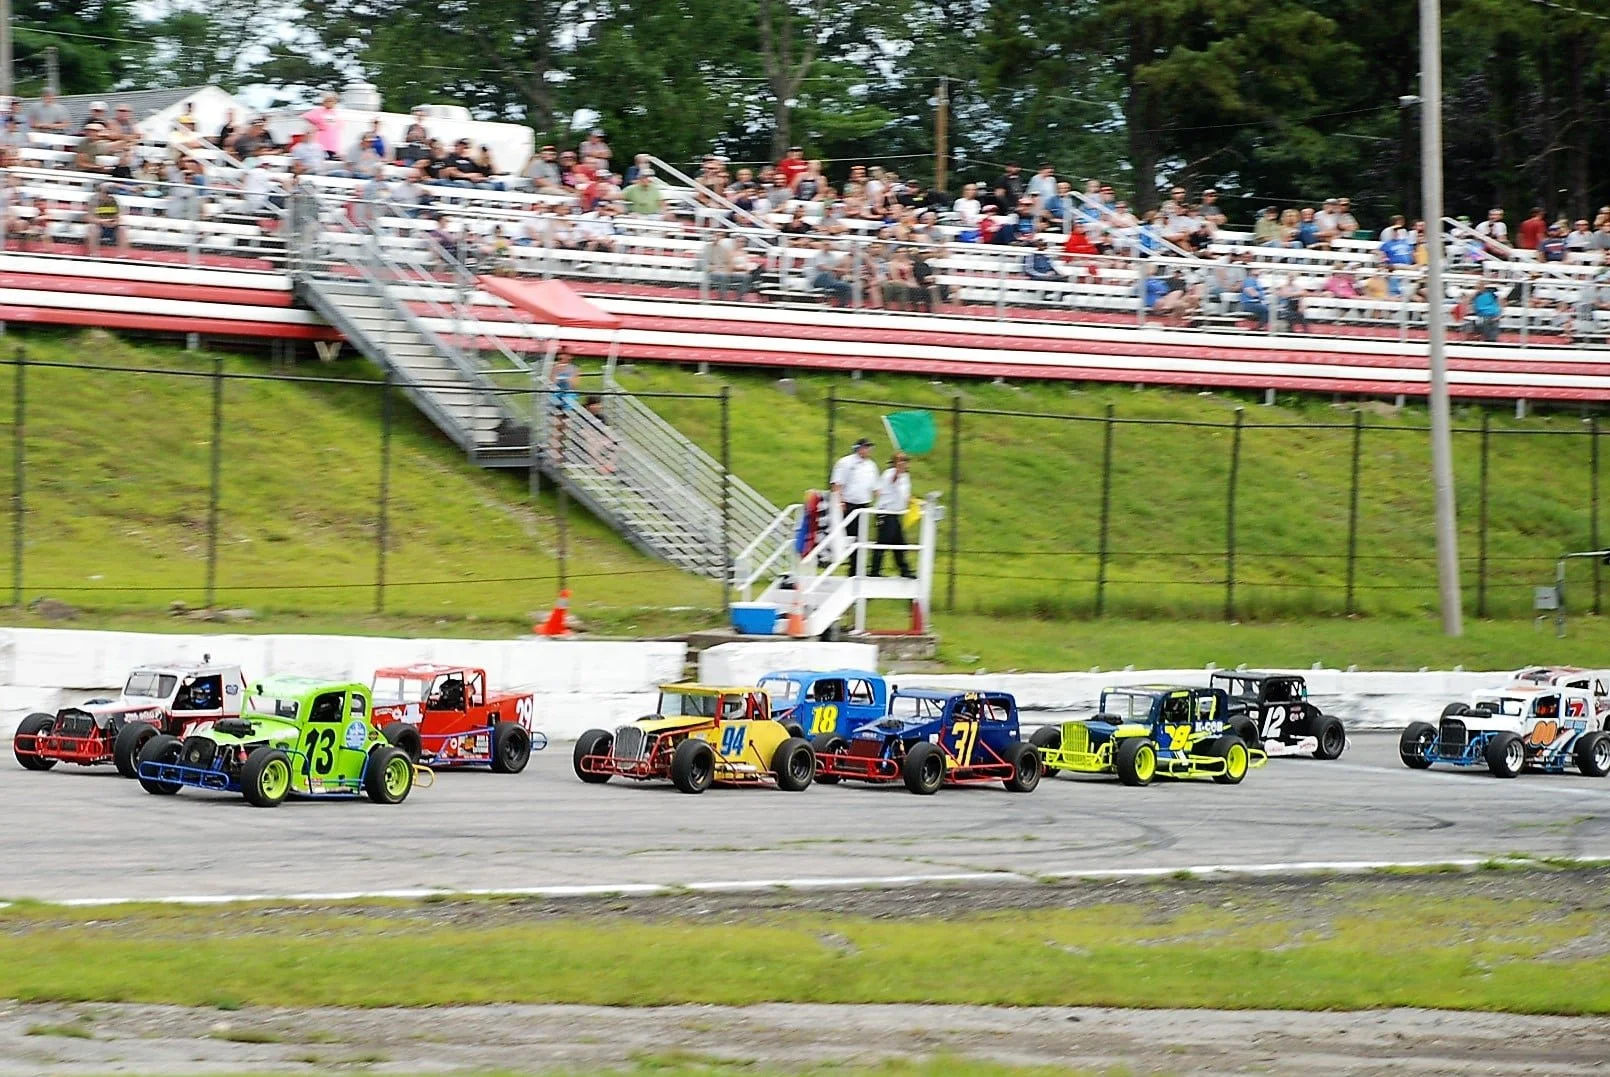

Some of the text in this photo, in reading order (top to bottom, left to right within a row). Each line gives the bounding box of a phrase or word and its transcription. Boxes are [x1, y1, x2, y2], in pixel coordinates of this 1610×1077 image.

[809, 704, 838, 734] 18
[1261, 705, 1286, 738] 12
[301, 727, 336, 775] 13
[720, 725, 747, 756] 94
[945, 721, 978, 768] 31
